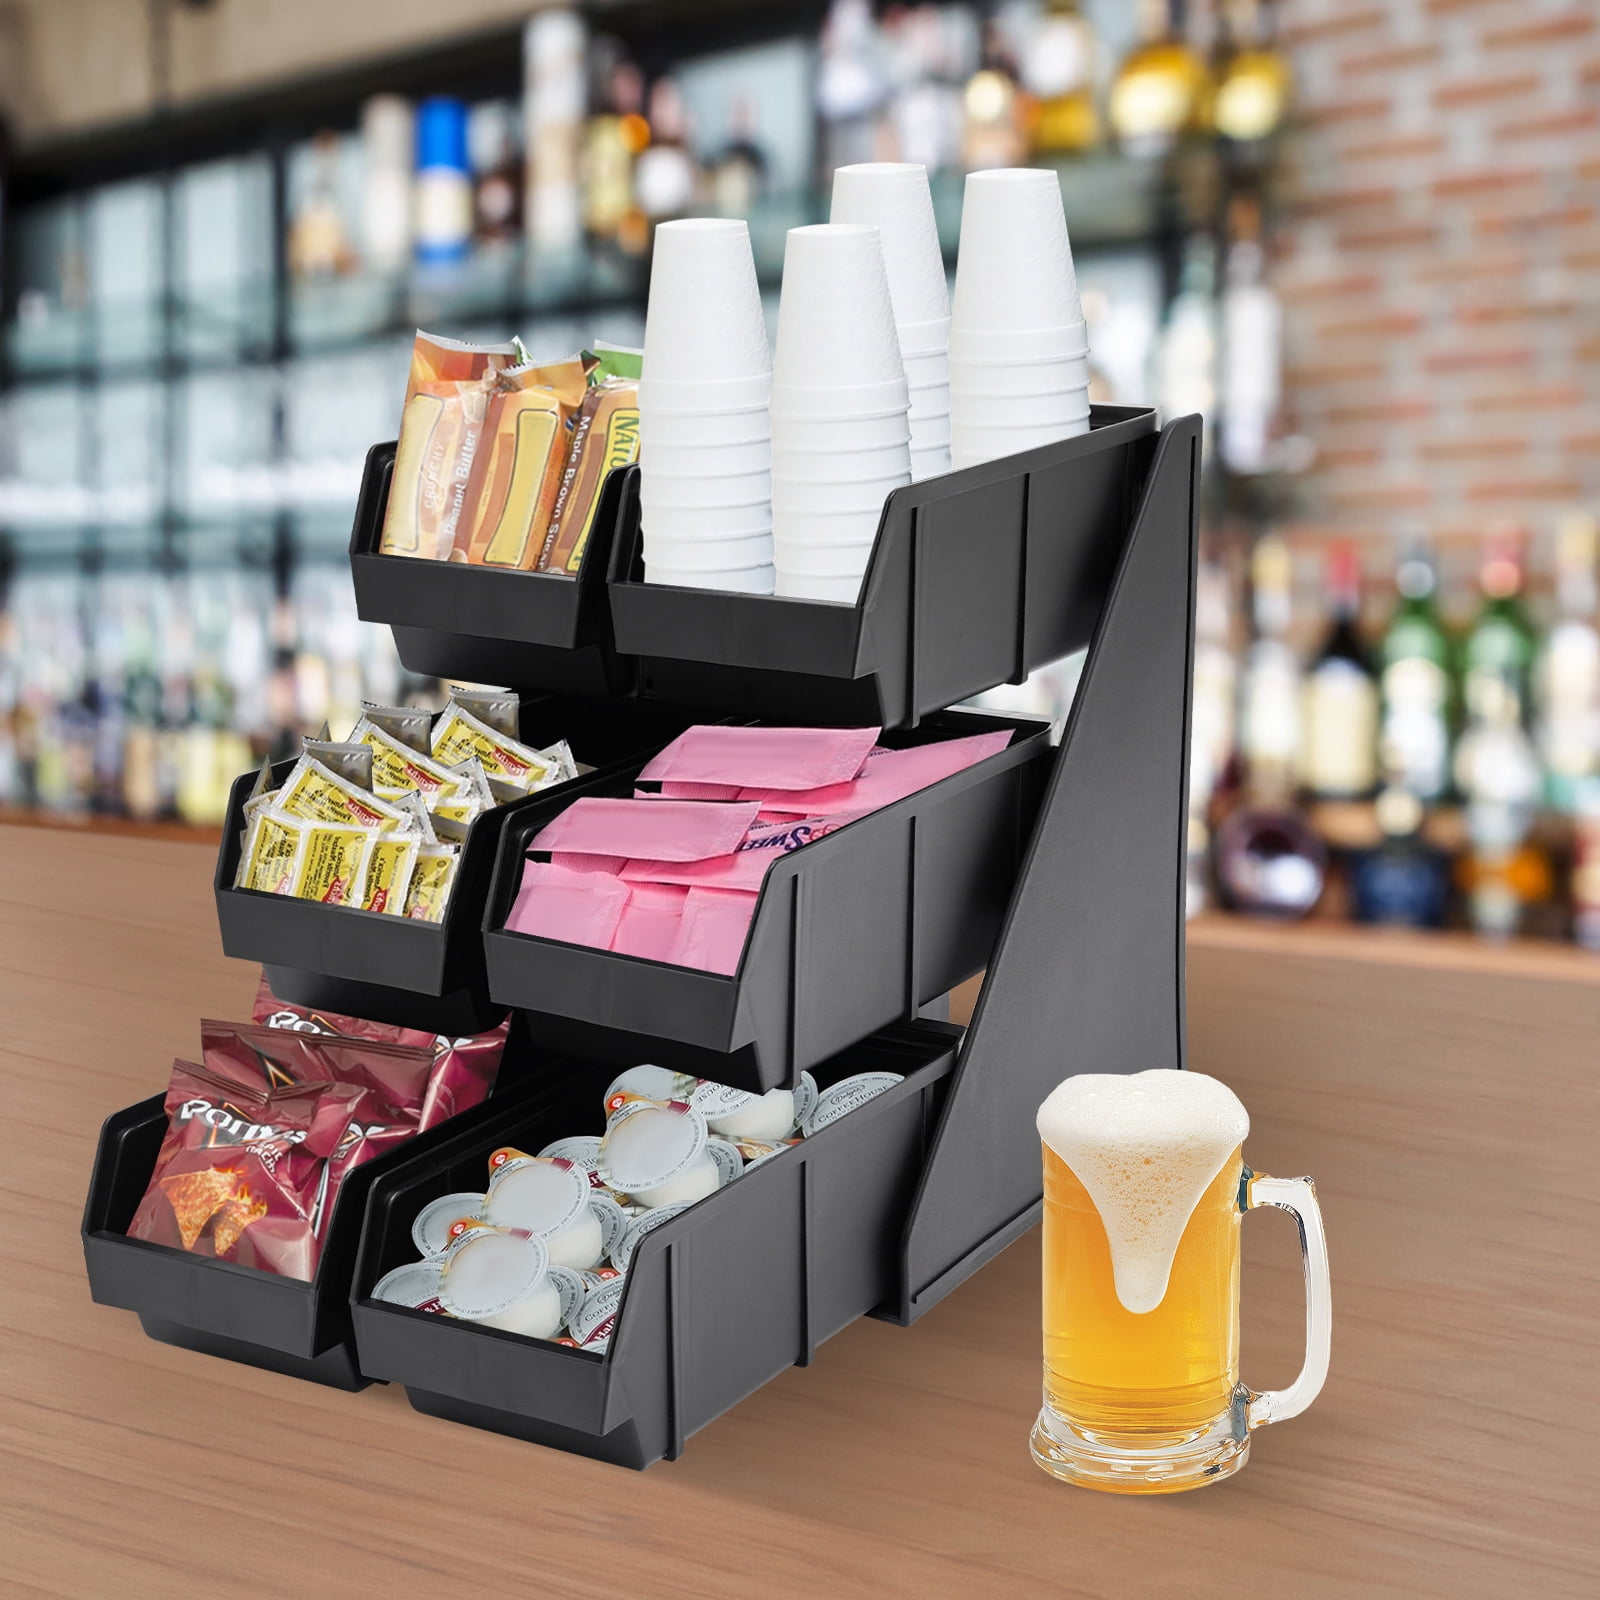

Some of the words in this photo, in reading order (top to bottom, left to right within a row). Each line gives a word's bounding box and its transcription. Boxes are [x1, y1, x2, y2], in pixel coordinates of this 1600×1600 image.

[570, 416, 591, 464] Maple
[611, 416, 640, 467] NATU
[444, 483, 465, 536] Peanut
[456, 430, 477, 479] Butter
[553, 467, 577, 518] Brown
[257, 1141, 283, 1161] SPIC
